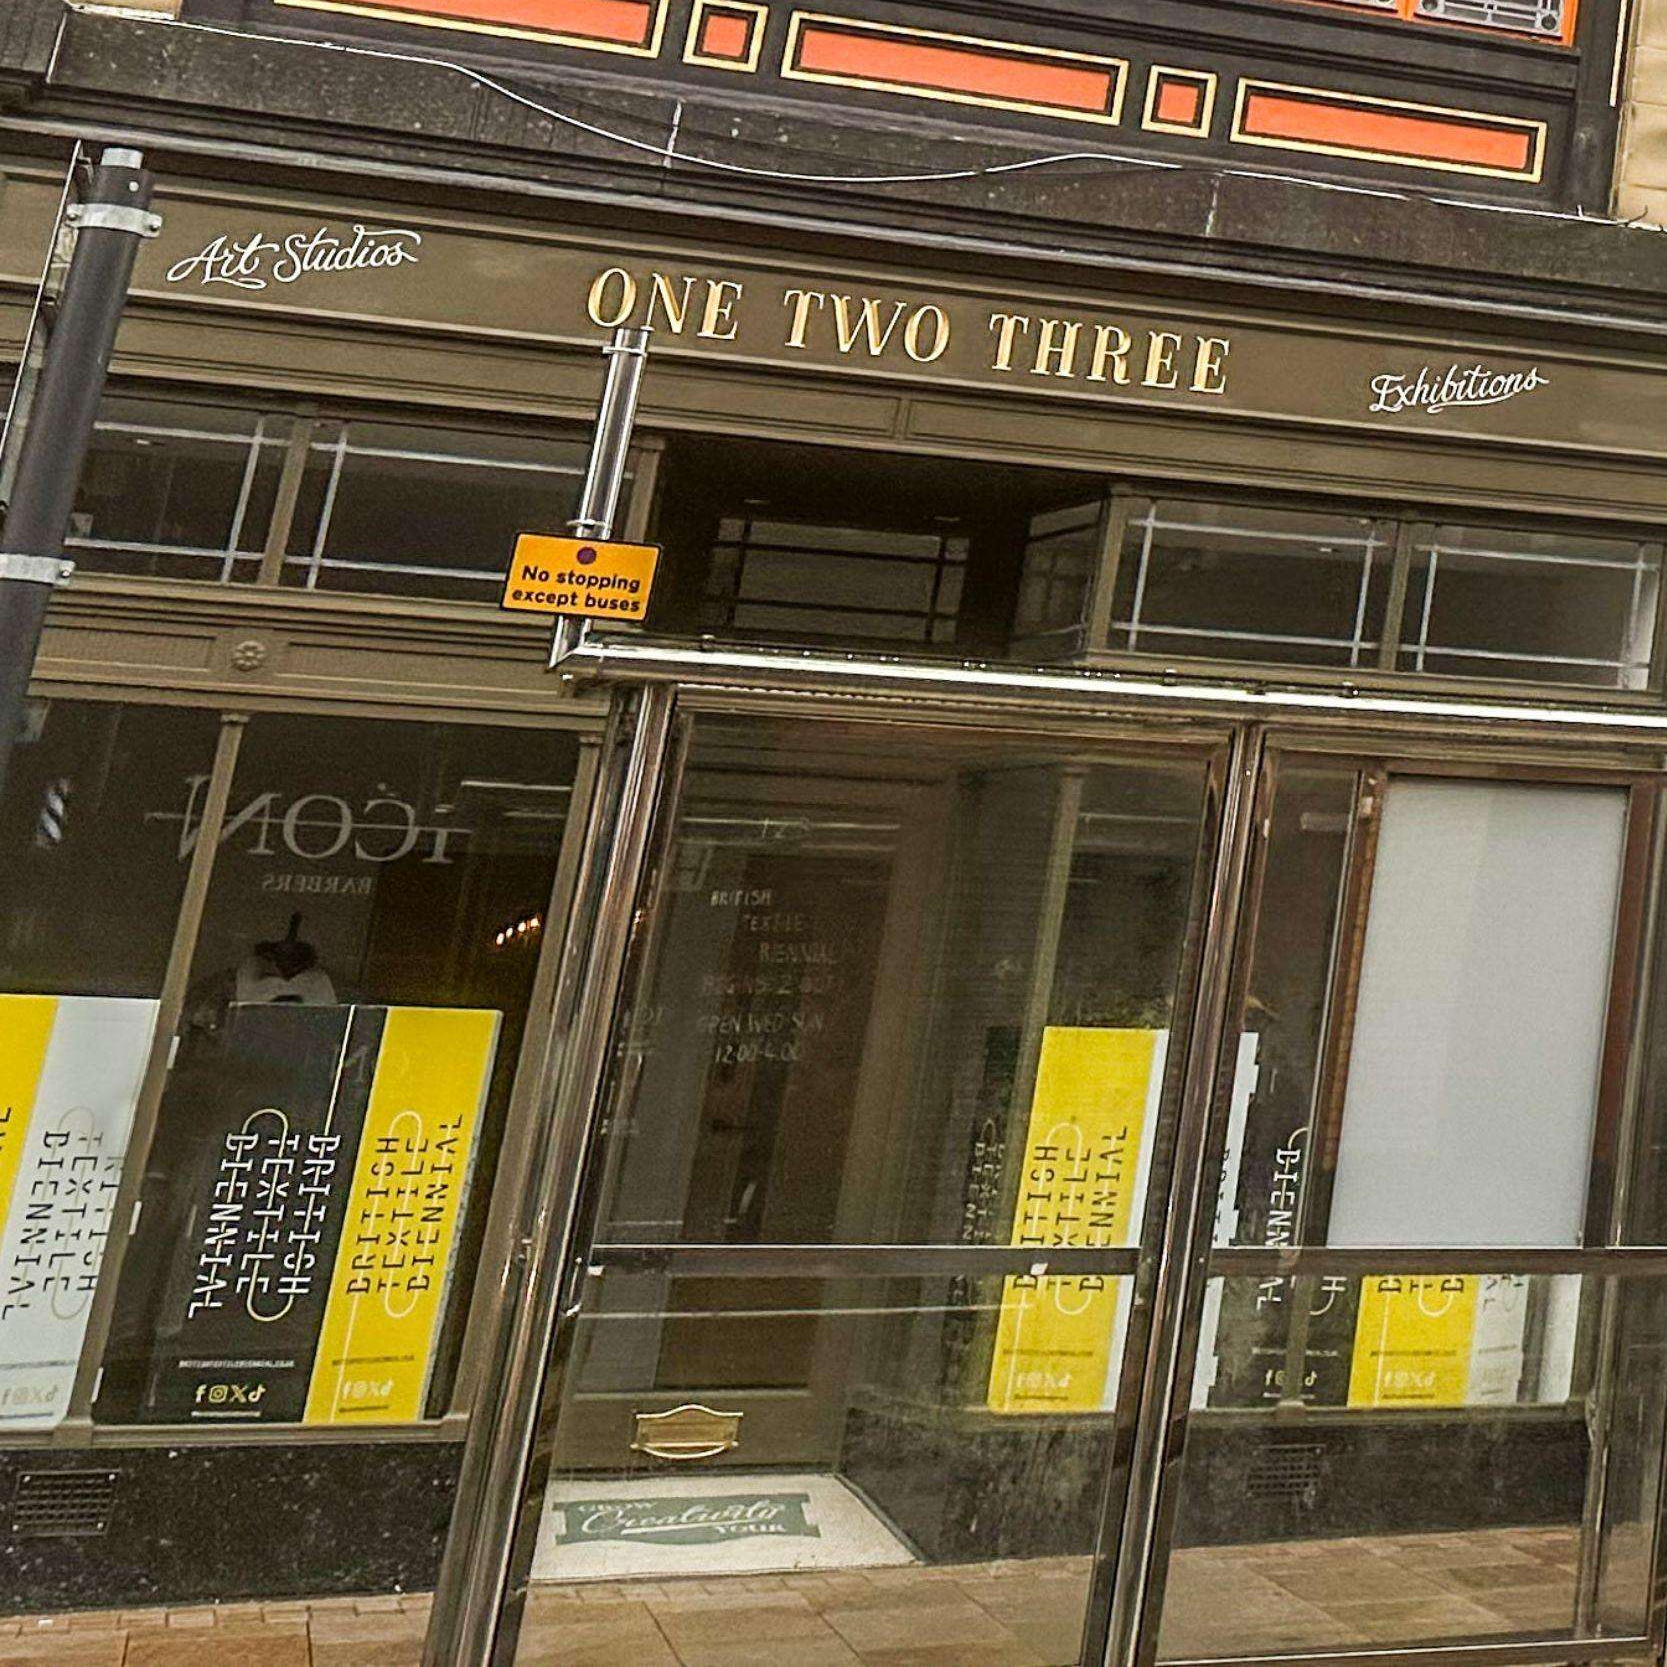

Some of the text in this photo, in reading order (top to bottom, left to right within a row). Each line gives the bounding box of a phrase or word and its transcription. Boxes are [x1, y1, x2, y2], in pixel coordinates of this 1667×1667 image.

[166, 224, 422, 290] Art Studios
[587, 266, 1233, 395] ONE TWO THREE
[1368, 364, 1550, 416] Exhibitions
[512, 589, 641, 613] except buses
[521, 565, 641, 594] No stopping
